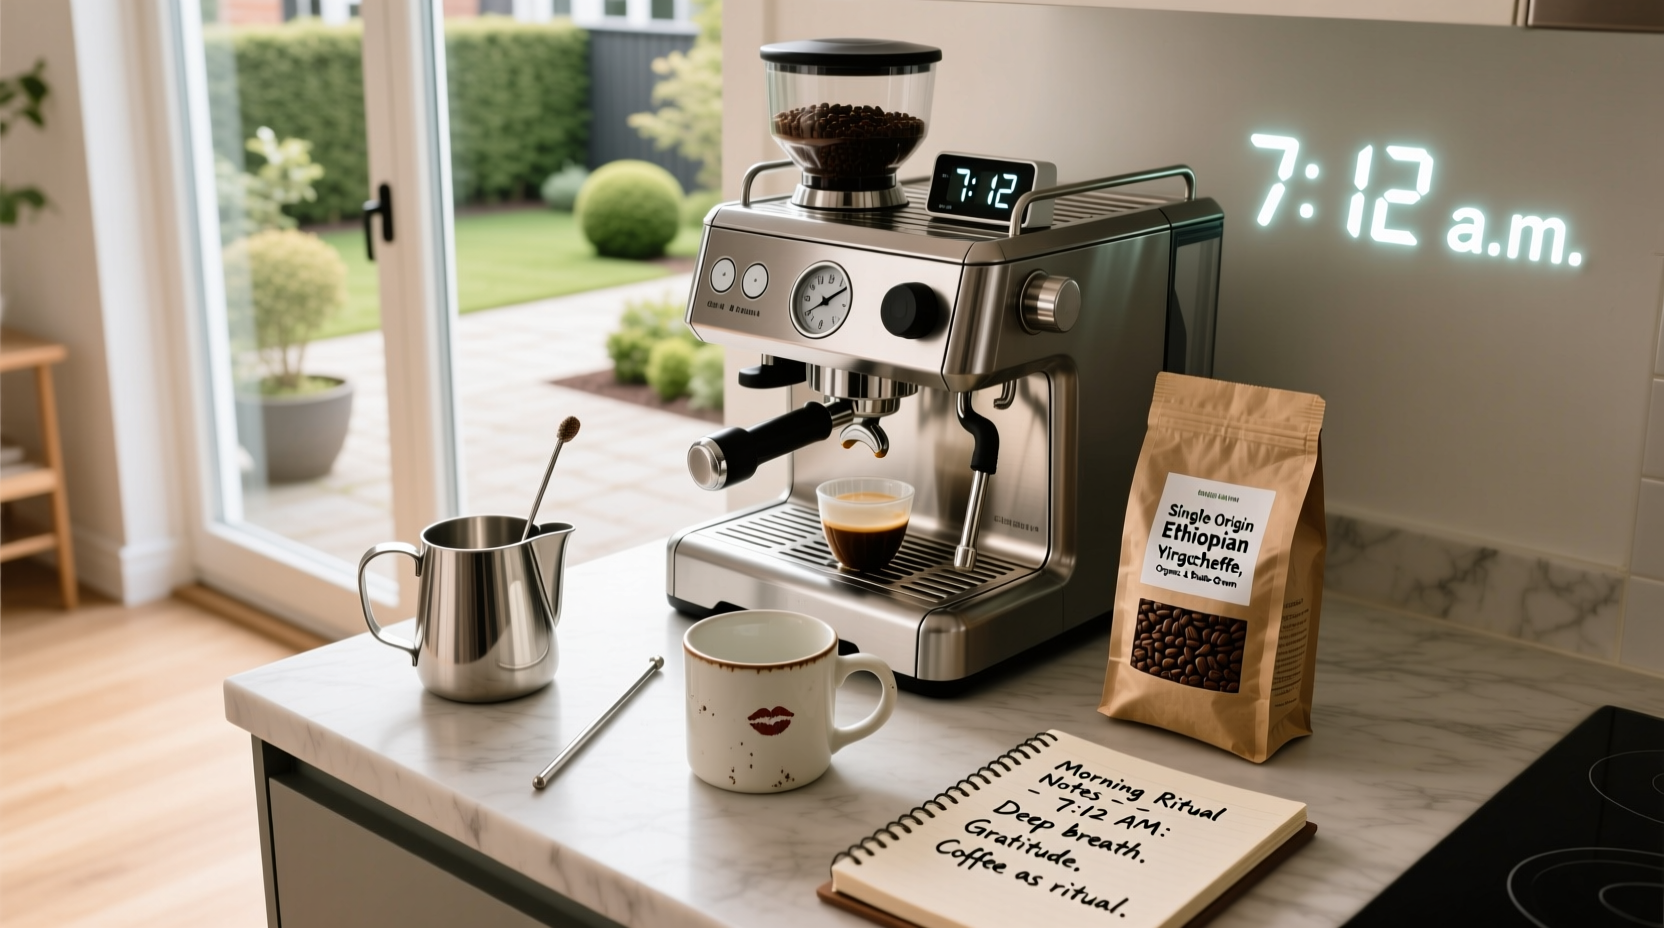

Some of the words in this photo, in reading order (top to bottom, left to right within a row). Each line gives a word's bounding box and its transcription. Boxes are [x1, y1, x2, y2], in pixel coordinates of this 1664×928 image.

[956, 167, 1018, 209] 7:12
[1250, 133, 1434, 246] 7:12
[1447, 206, 1582, 267] a.m.
[1161, 520, 1249, 553] Ethiopian
[1168, 503, 1211, 525] Single
[1214, 513, 1254, 533] Origin
[1038, 773, 1103, 800] Notes
[1054, 760, 1145, 803] Morning
[1153, 791, 1227, 822] Ritual
[993, 799, 1055, 833] Deep
[1061, 823, 1145, 864] breath.
[1056, 796, 1108, 821] 7:12
[1113, 815, 1171, 837] AM:
[964, 819, 1080, 872] Gratitude.
[935, 839, 1007, 875] Coffee
[1015, 870, 1043, 886] as
[1049, 882, 1129, 918] ritual.
